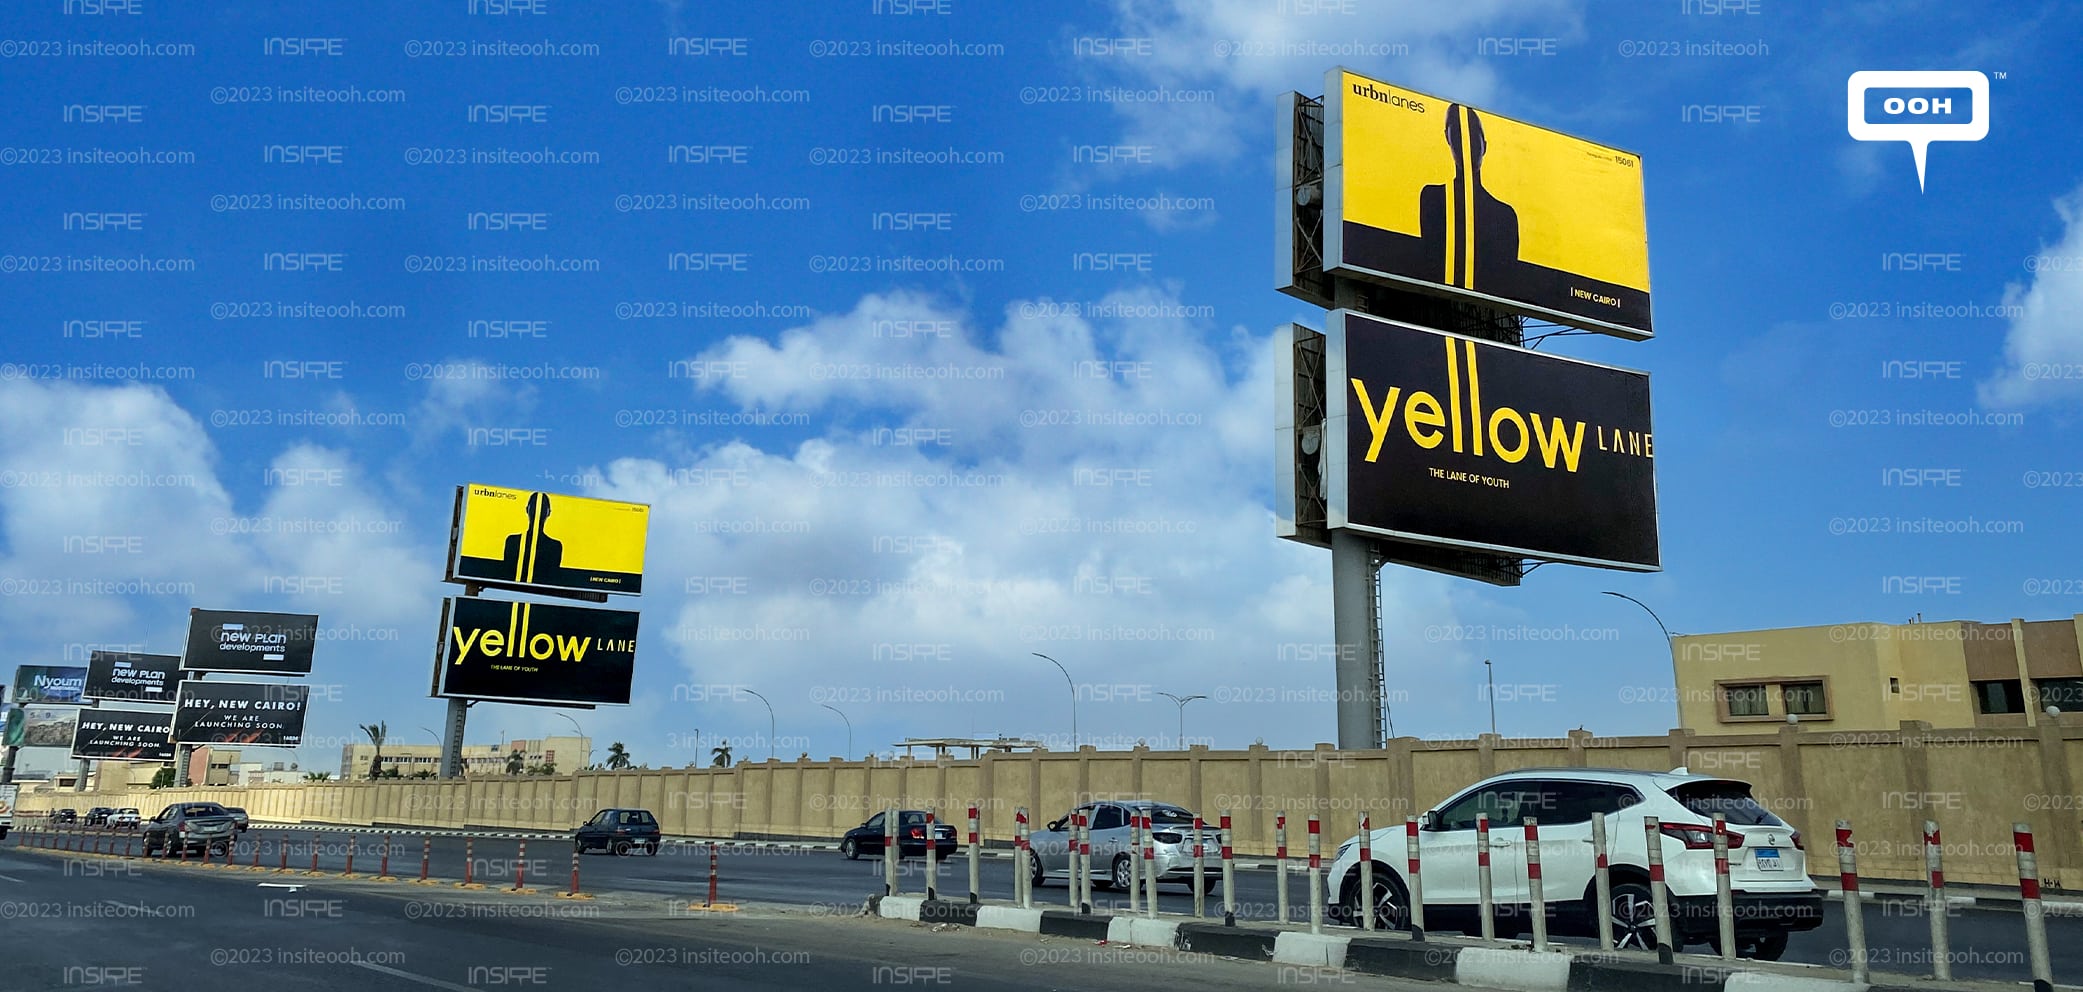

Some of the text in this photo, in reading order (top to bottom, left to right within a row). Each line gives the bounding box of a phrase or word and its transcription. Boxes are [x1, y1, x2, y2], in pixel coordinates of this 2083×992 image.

[1352, 82, 1425, 114] urbnlanes
[1574, 288, 1617, 306] NEW CAIRO
[1350, 336, 1653, 473] yellow LANE
[1428, 467, 1510, 489] THE LANE OF YOUTH
[453, 602, 636, 666] yellow LANE
[219, 642, 286, 653] developments
[111, 676, 164, 686] developments
[184, 698, 301, 711] HEY, NEW CAIRO!
[81, 721, 107, 731] HEY,
[109, 723, 134, 732] NEW
[194, 721, 251, 729] LAUNCHING
[89, 739, 135, 747] LAUNCHING
